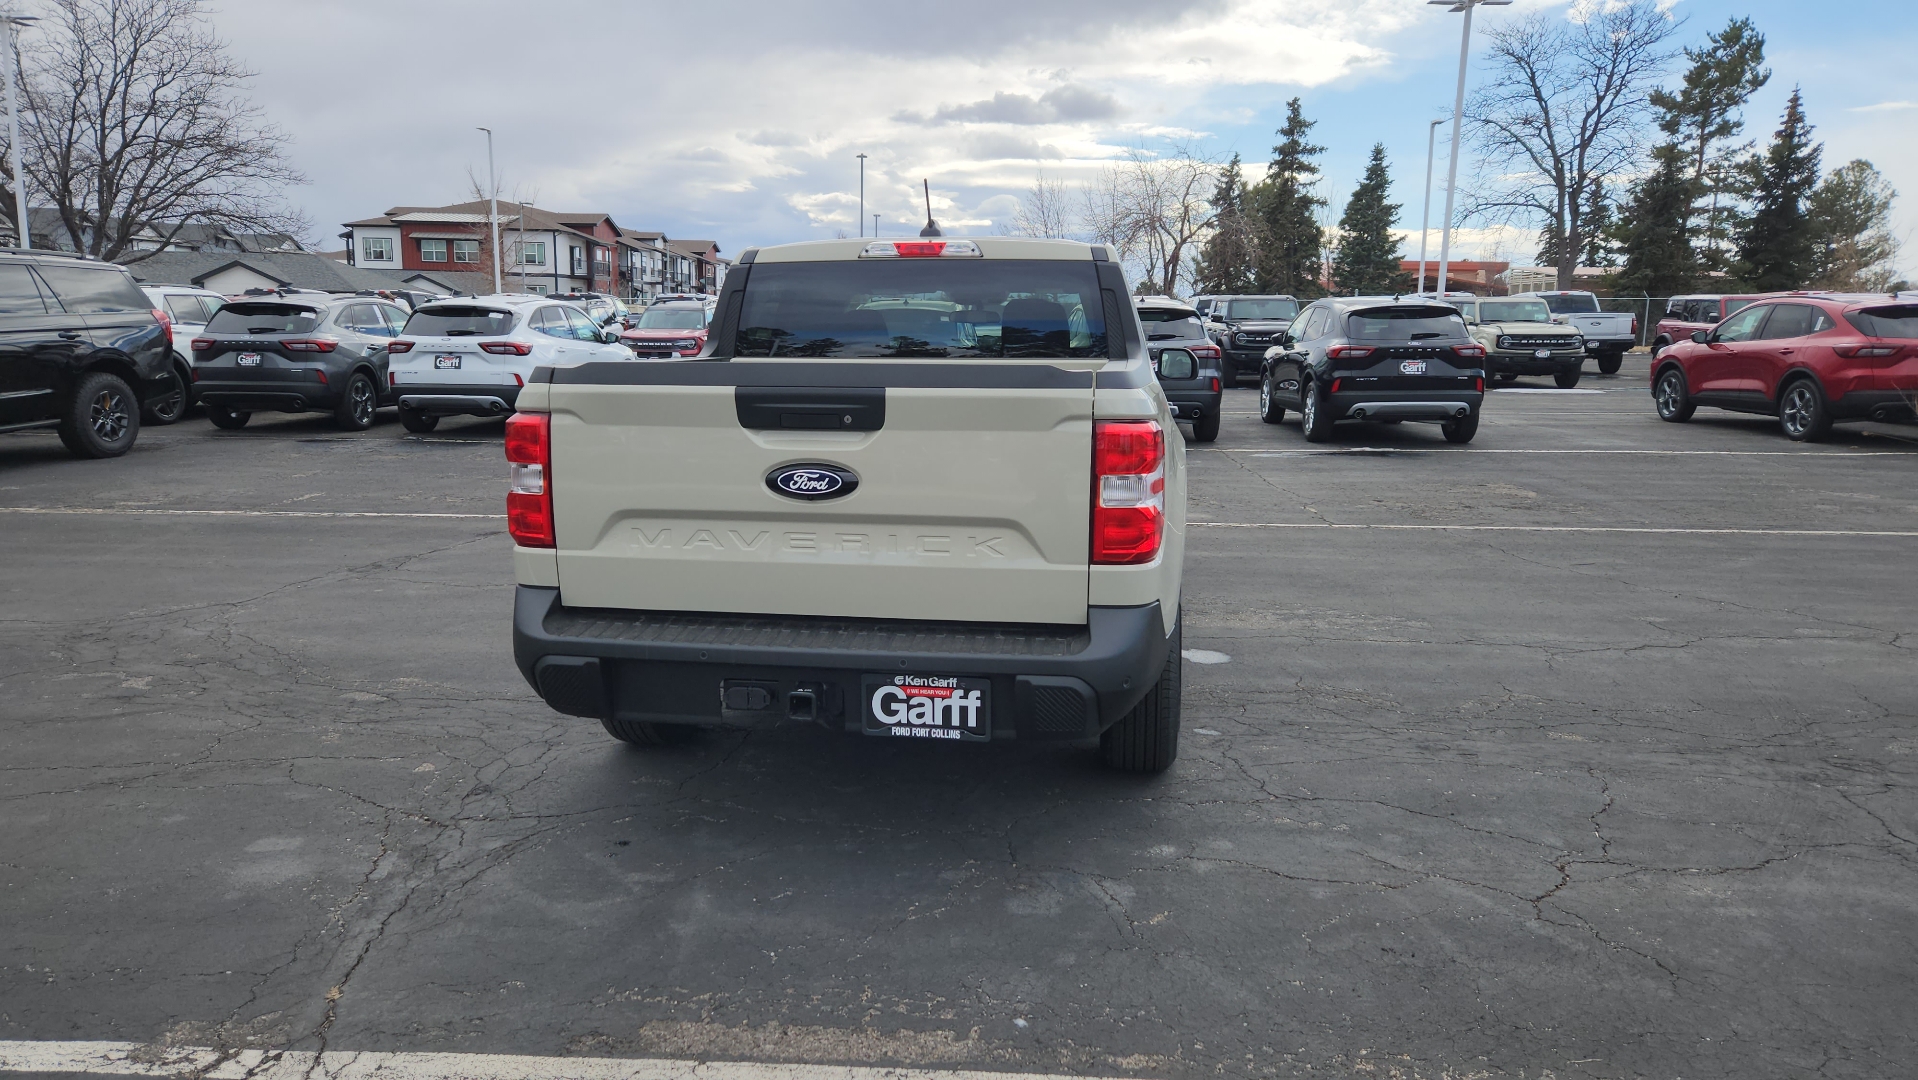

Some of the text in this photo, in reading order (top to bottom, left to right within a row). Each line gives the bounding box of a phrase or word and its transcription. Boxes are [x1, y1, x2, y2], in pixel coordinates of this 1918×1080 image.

[237, 354, 261, 364] Garff
[435, 357, 460, 367] Garff
[1400, 362, 1427, 372] Garff
[789, 472, 829, 490] Ford
[630, 527, 1004, 557] MAVERICK
[905, 675, 957, 688] Ken Garff
[871, 685, 981, 727] Garff
[891, 726, 961, 740] FORD FORT COLLINS
